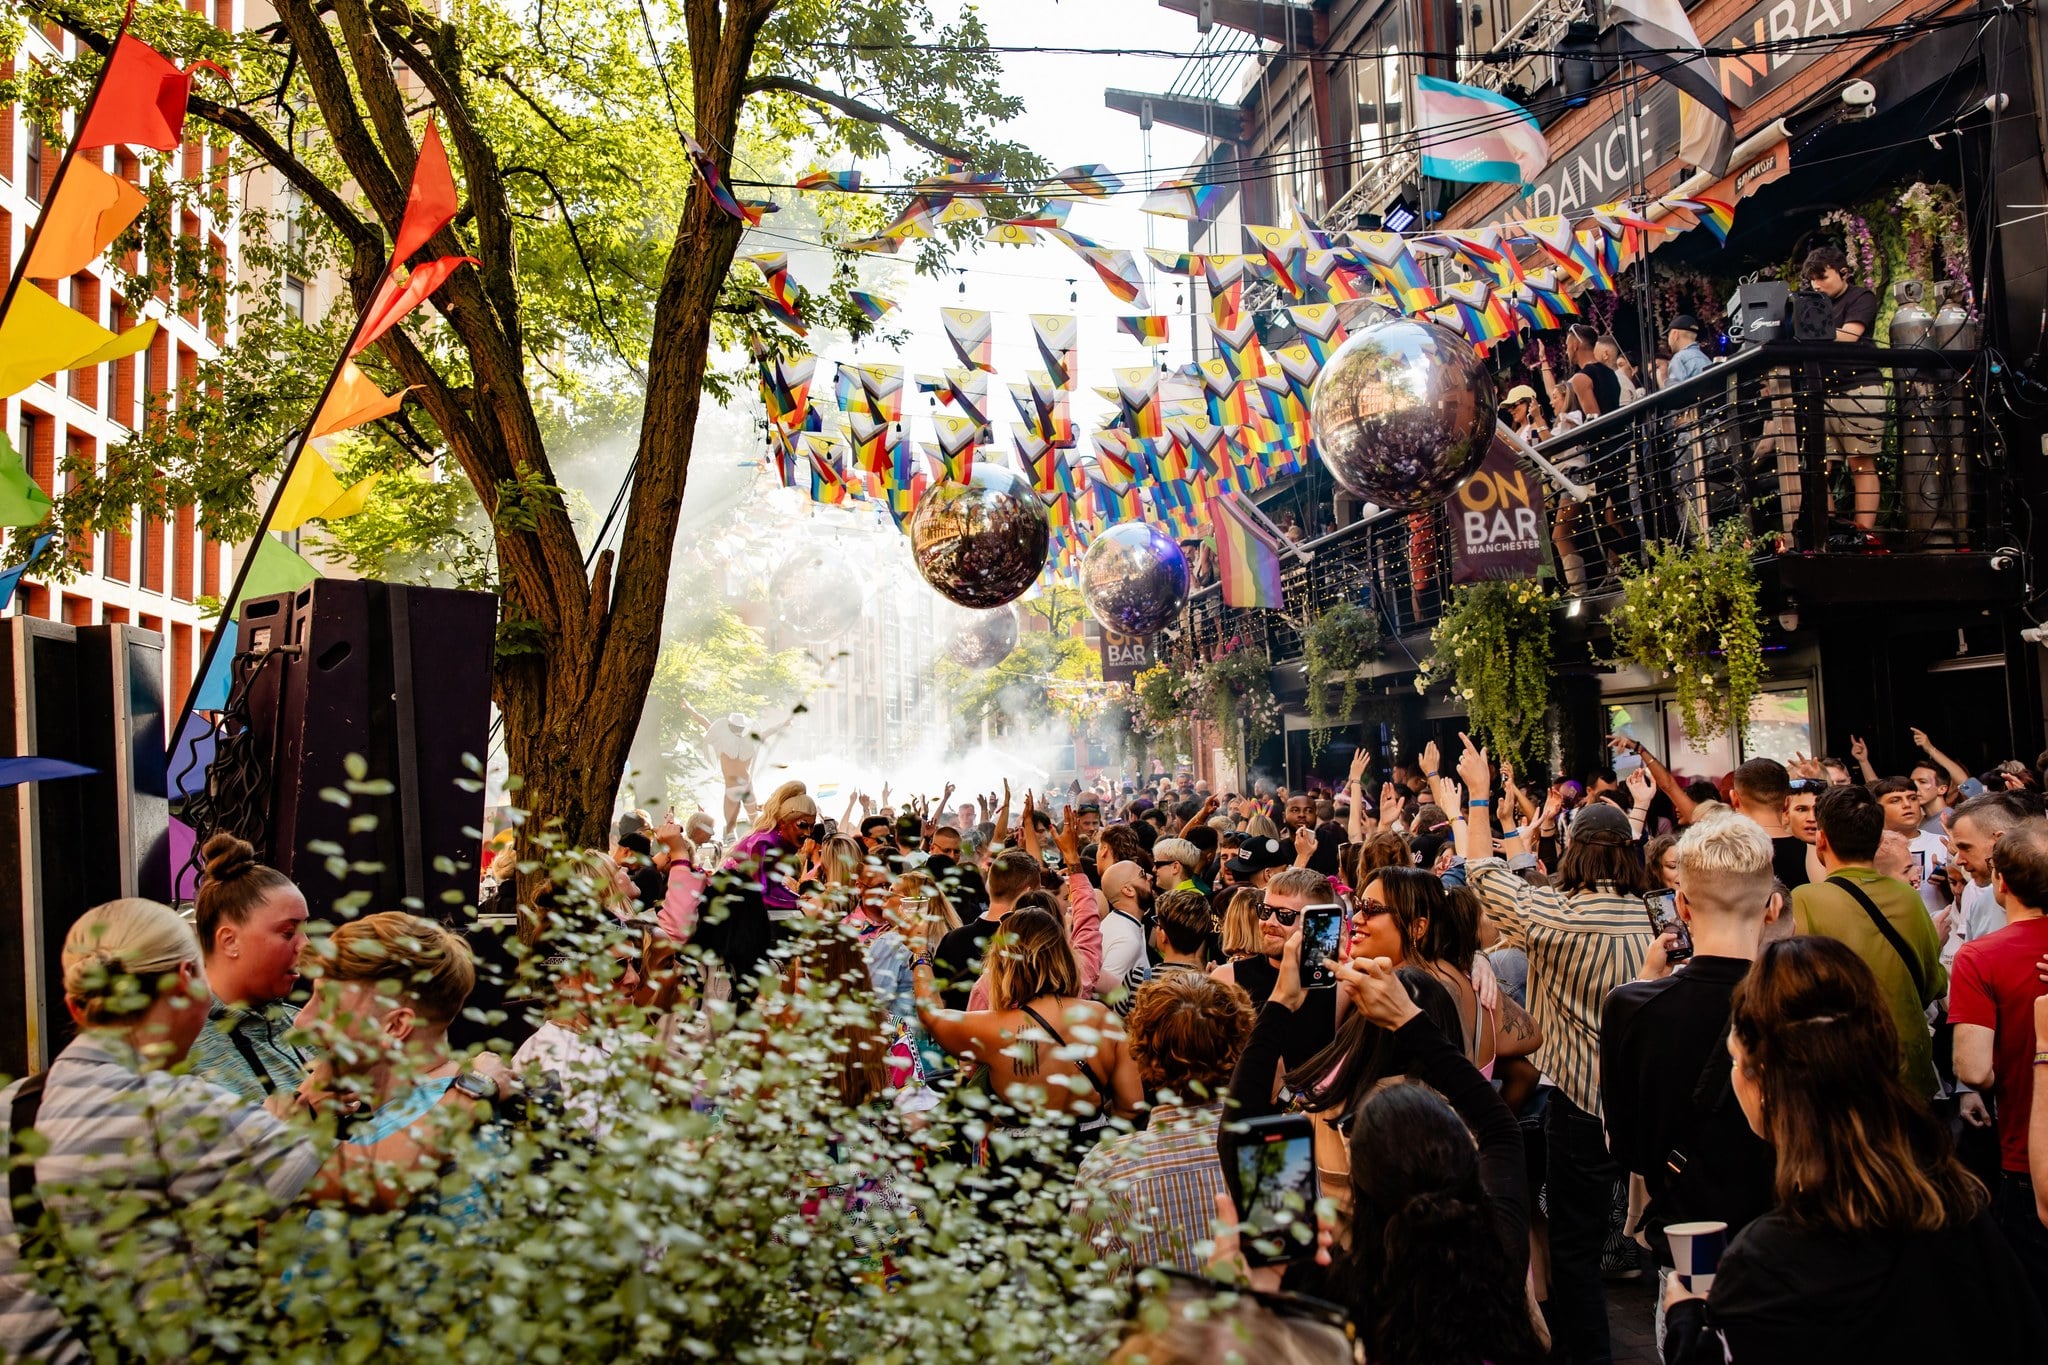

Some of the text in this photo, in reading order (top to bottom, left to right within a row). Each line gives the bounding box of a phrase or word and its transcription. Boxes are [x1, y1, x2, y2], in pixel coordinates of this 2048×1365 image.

[1459, 470, 1530, 512] ON
[1464, 508, 1538, 545] BAR
[1467, 540, 1540, 555] MANCHESTER
[1108, 645, 1146, 662] BAR
